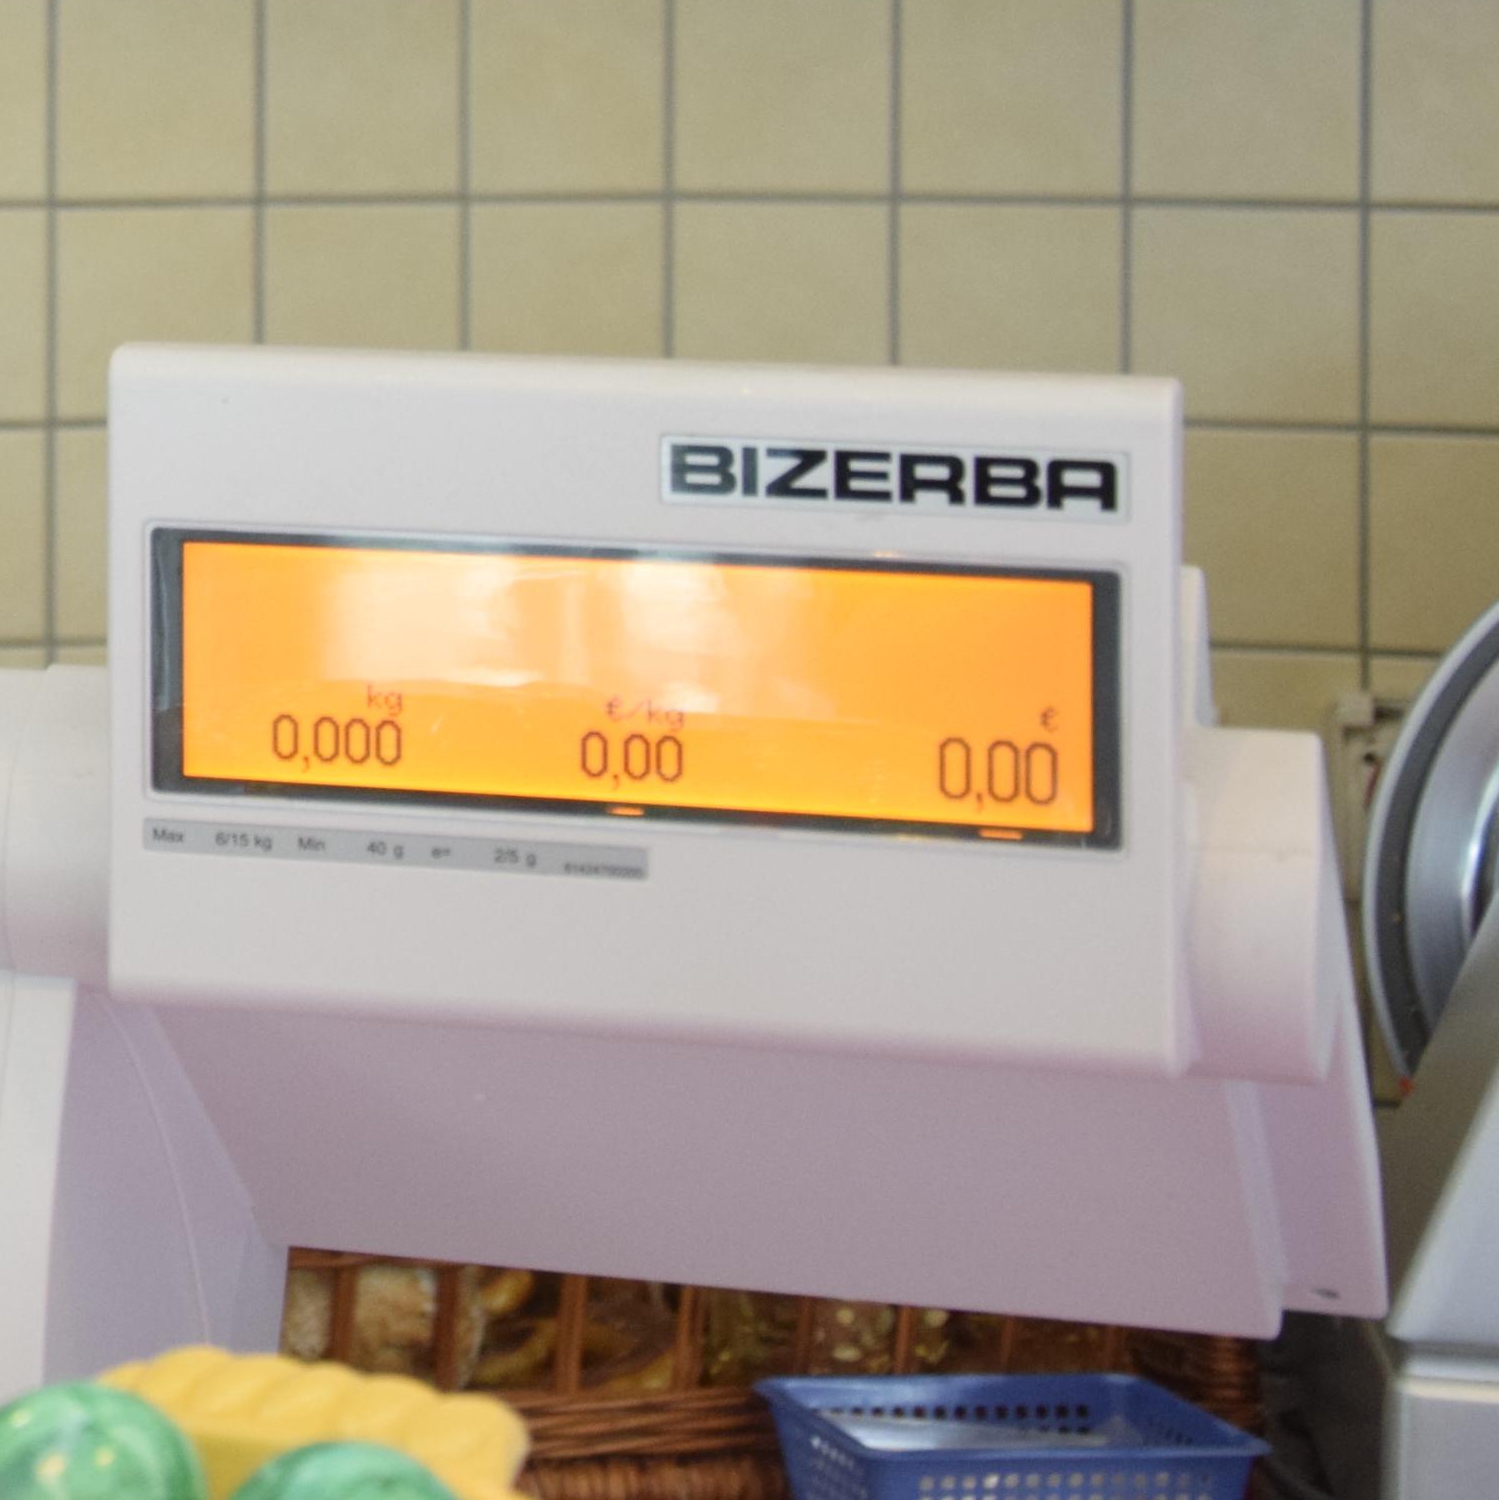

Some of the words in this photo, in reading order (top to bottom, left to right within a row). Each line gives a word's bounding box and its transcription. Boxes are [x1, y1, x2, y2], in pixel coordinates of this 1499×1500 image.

[668, 443, 1120, 512] BIZERBA
[366, 683, 403, 715] kg
[605, 694, 686, 730] €/kg
[271, 713, 403, 773] 0,000
[580, 730, 686, 790] 0,00
[937, 736, 1060, 812] 0,00
[152, 827, 185, 844] Max
[253, 835, 273, 852] kg
[297, 835, 326, 851] Min
[366, 840, 387, 856] 40
